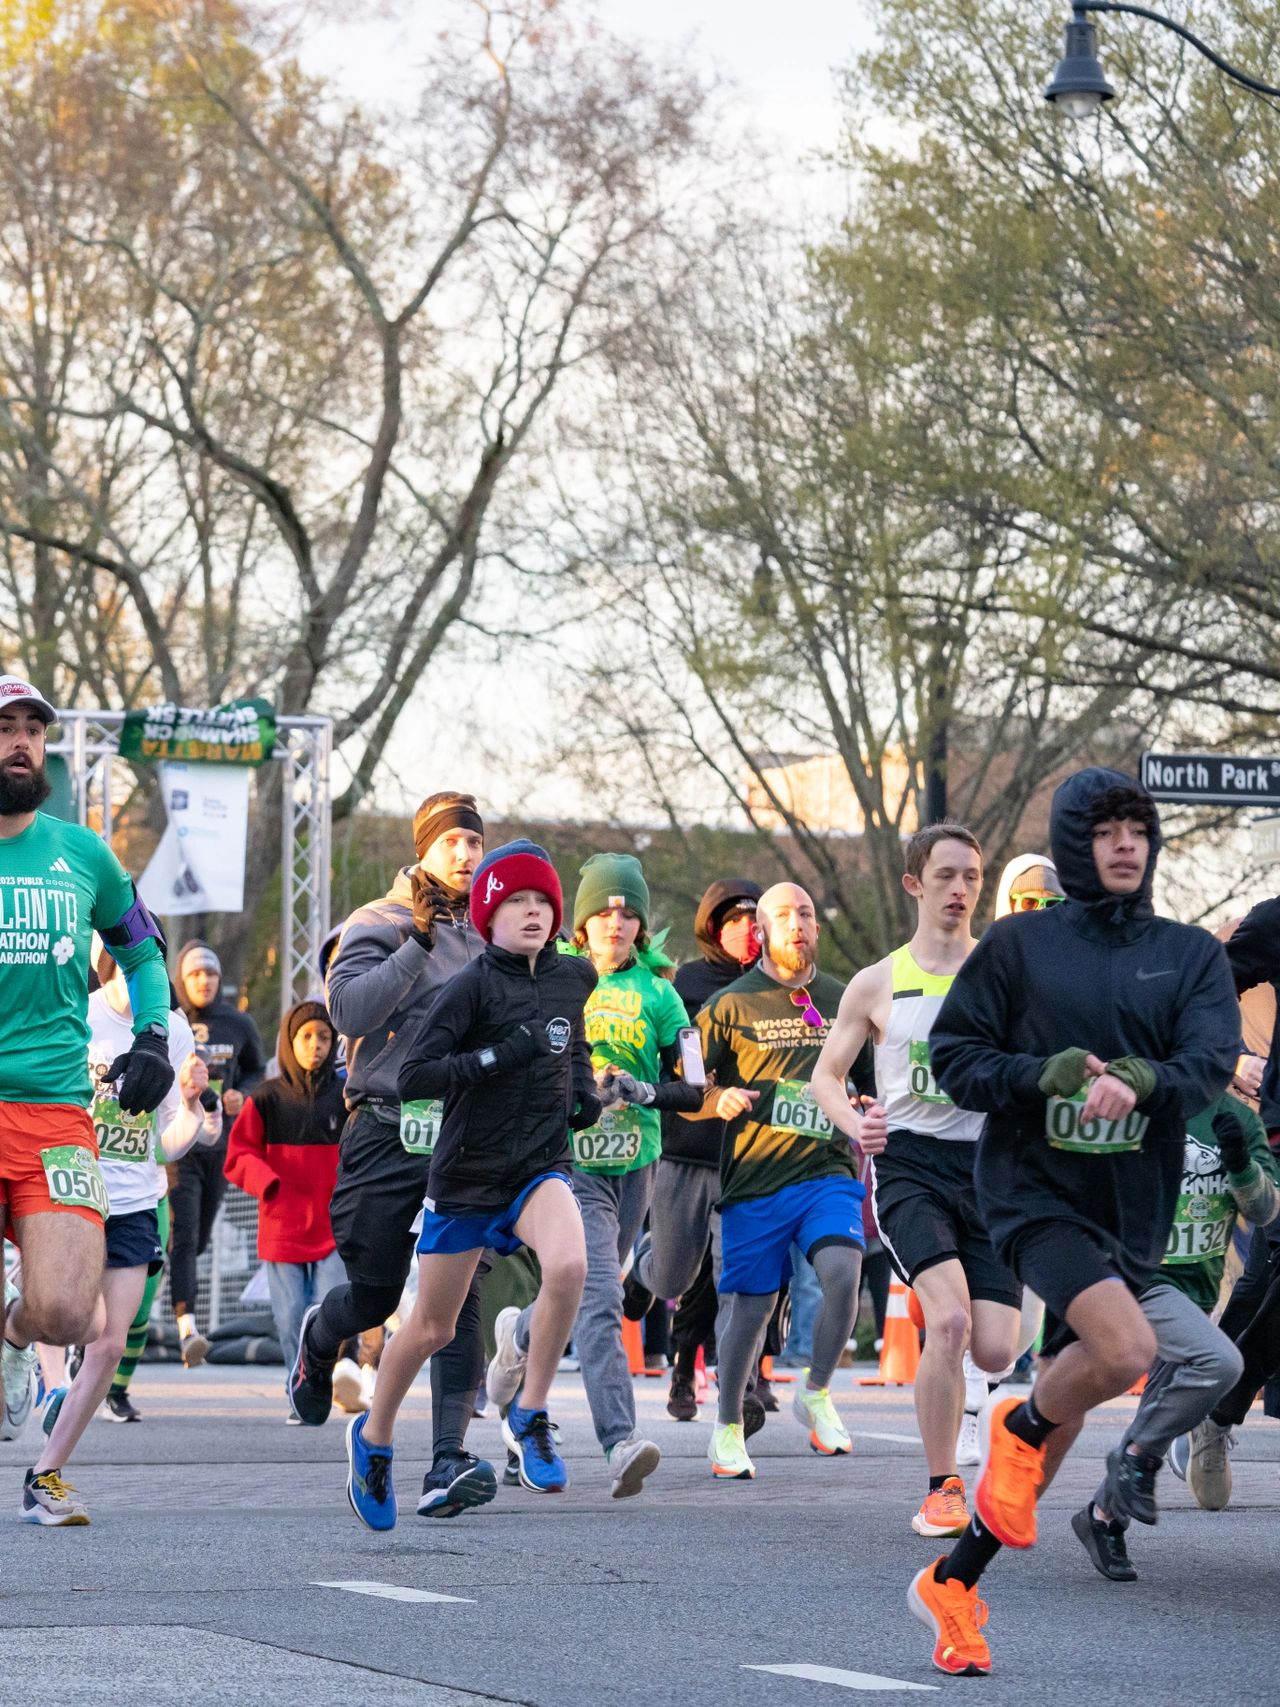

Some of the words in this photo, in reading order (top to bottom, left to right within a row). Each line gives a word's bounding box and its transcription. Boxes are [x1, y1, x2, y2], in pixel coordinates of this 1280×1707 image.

[1148, 760, 1209, 788] North
[1221, 763, 1269, 790] Park
[17, 876, 44, 886] PUBLIX
[550, 1024, 569, 1034] HOT
[756, 1027, 803, 1042] LOOK
[758, 1038, 800, 1052] DRINK
[95, 1123, 150, 1156] 0253
[578, 1133, 639, 1160] 0223
[1166, 1221, 1226, 1255] 0132
